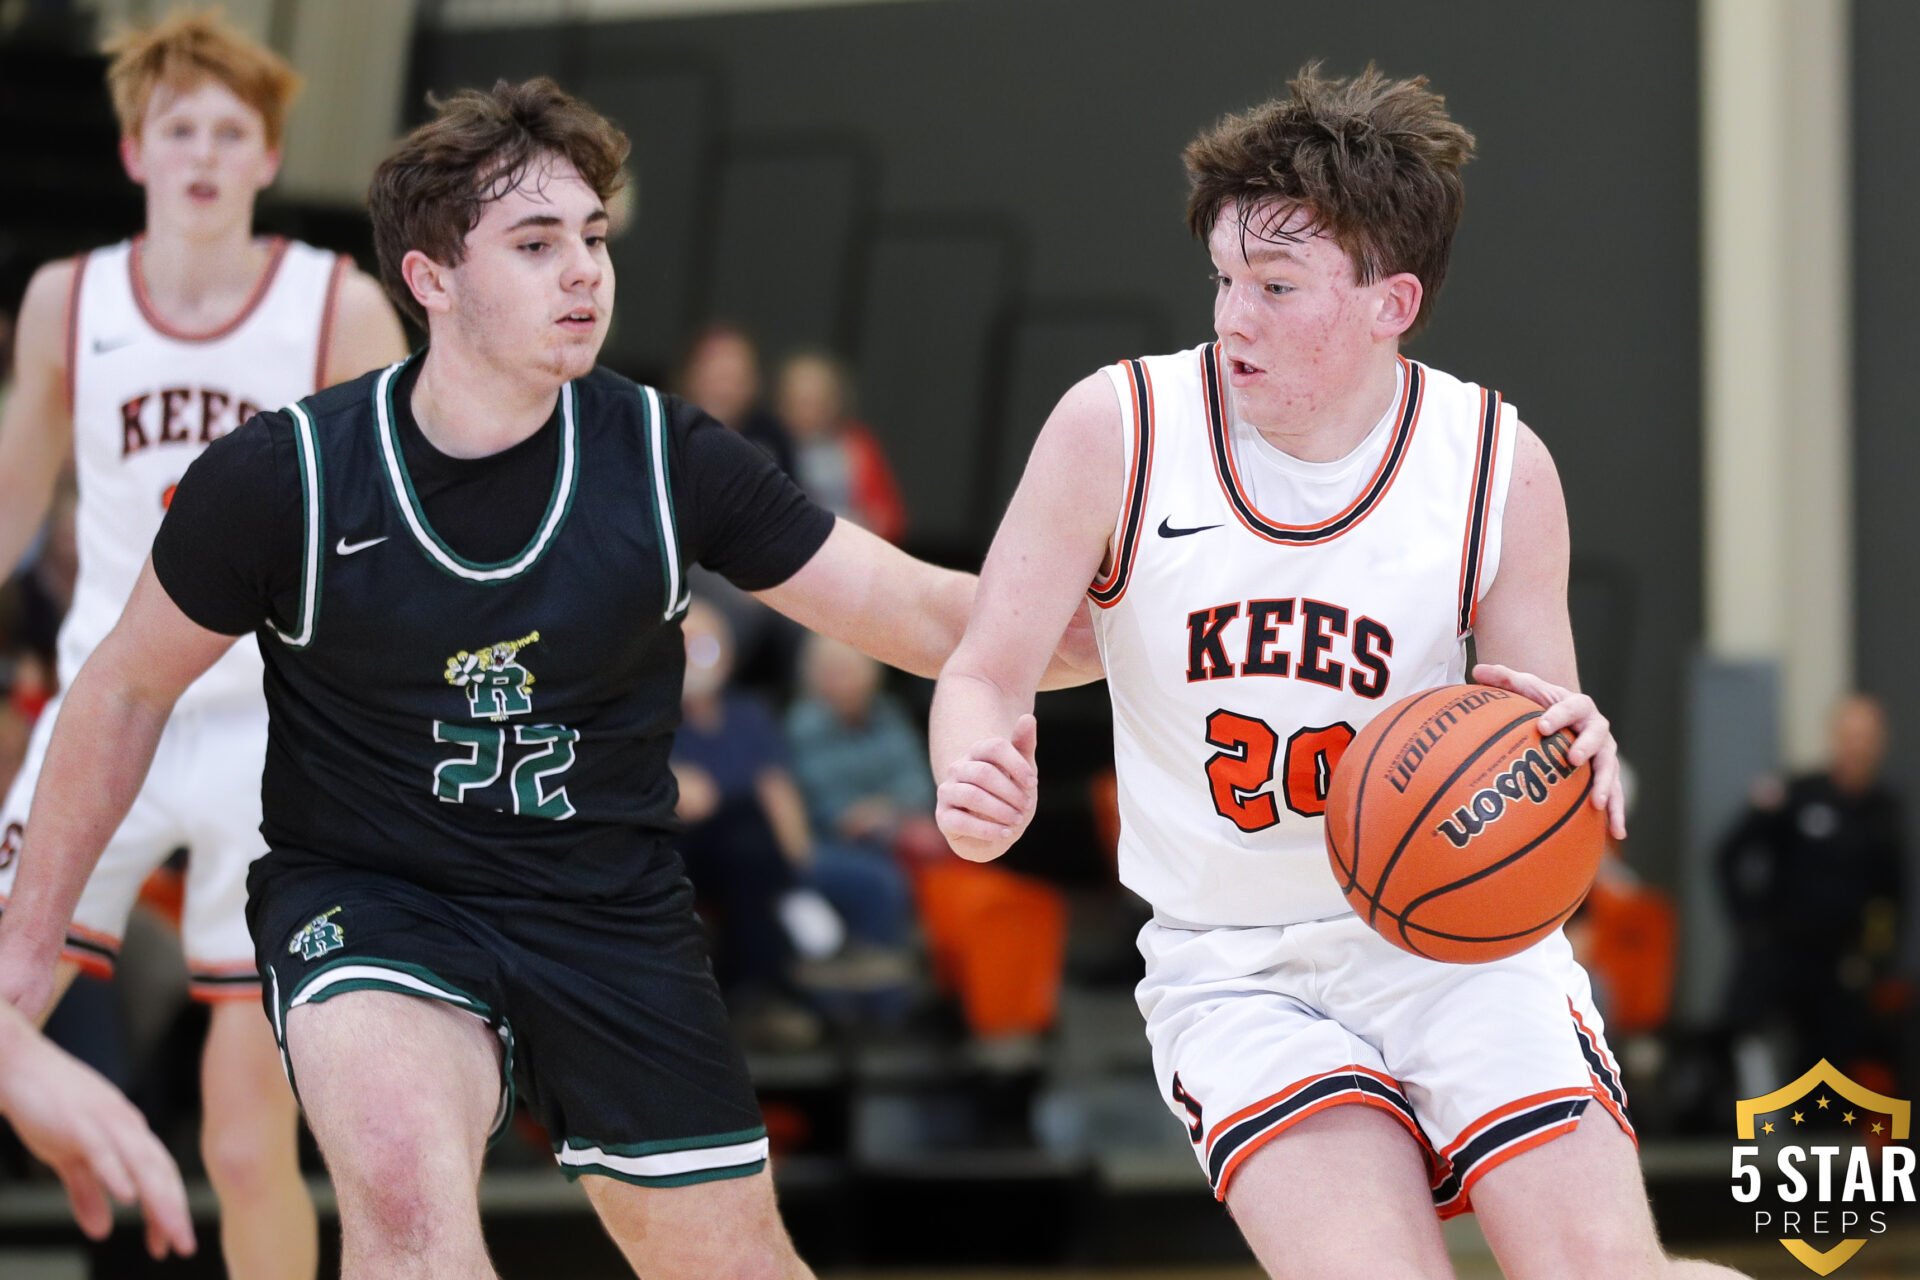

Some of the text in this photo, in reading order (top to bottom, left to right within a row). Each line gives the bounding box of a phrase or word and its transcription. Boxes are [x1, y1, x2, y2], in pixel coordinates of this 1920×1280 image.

[470, 663, 532, 718] R
[1186, 597, 1394, 700] KEES
[1204, 708, 1357, 833] 20
[1391, 691, 1510, 793] EVOLUTION
[1436, 731, 1579, 848] Wilson
